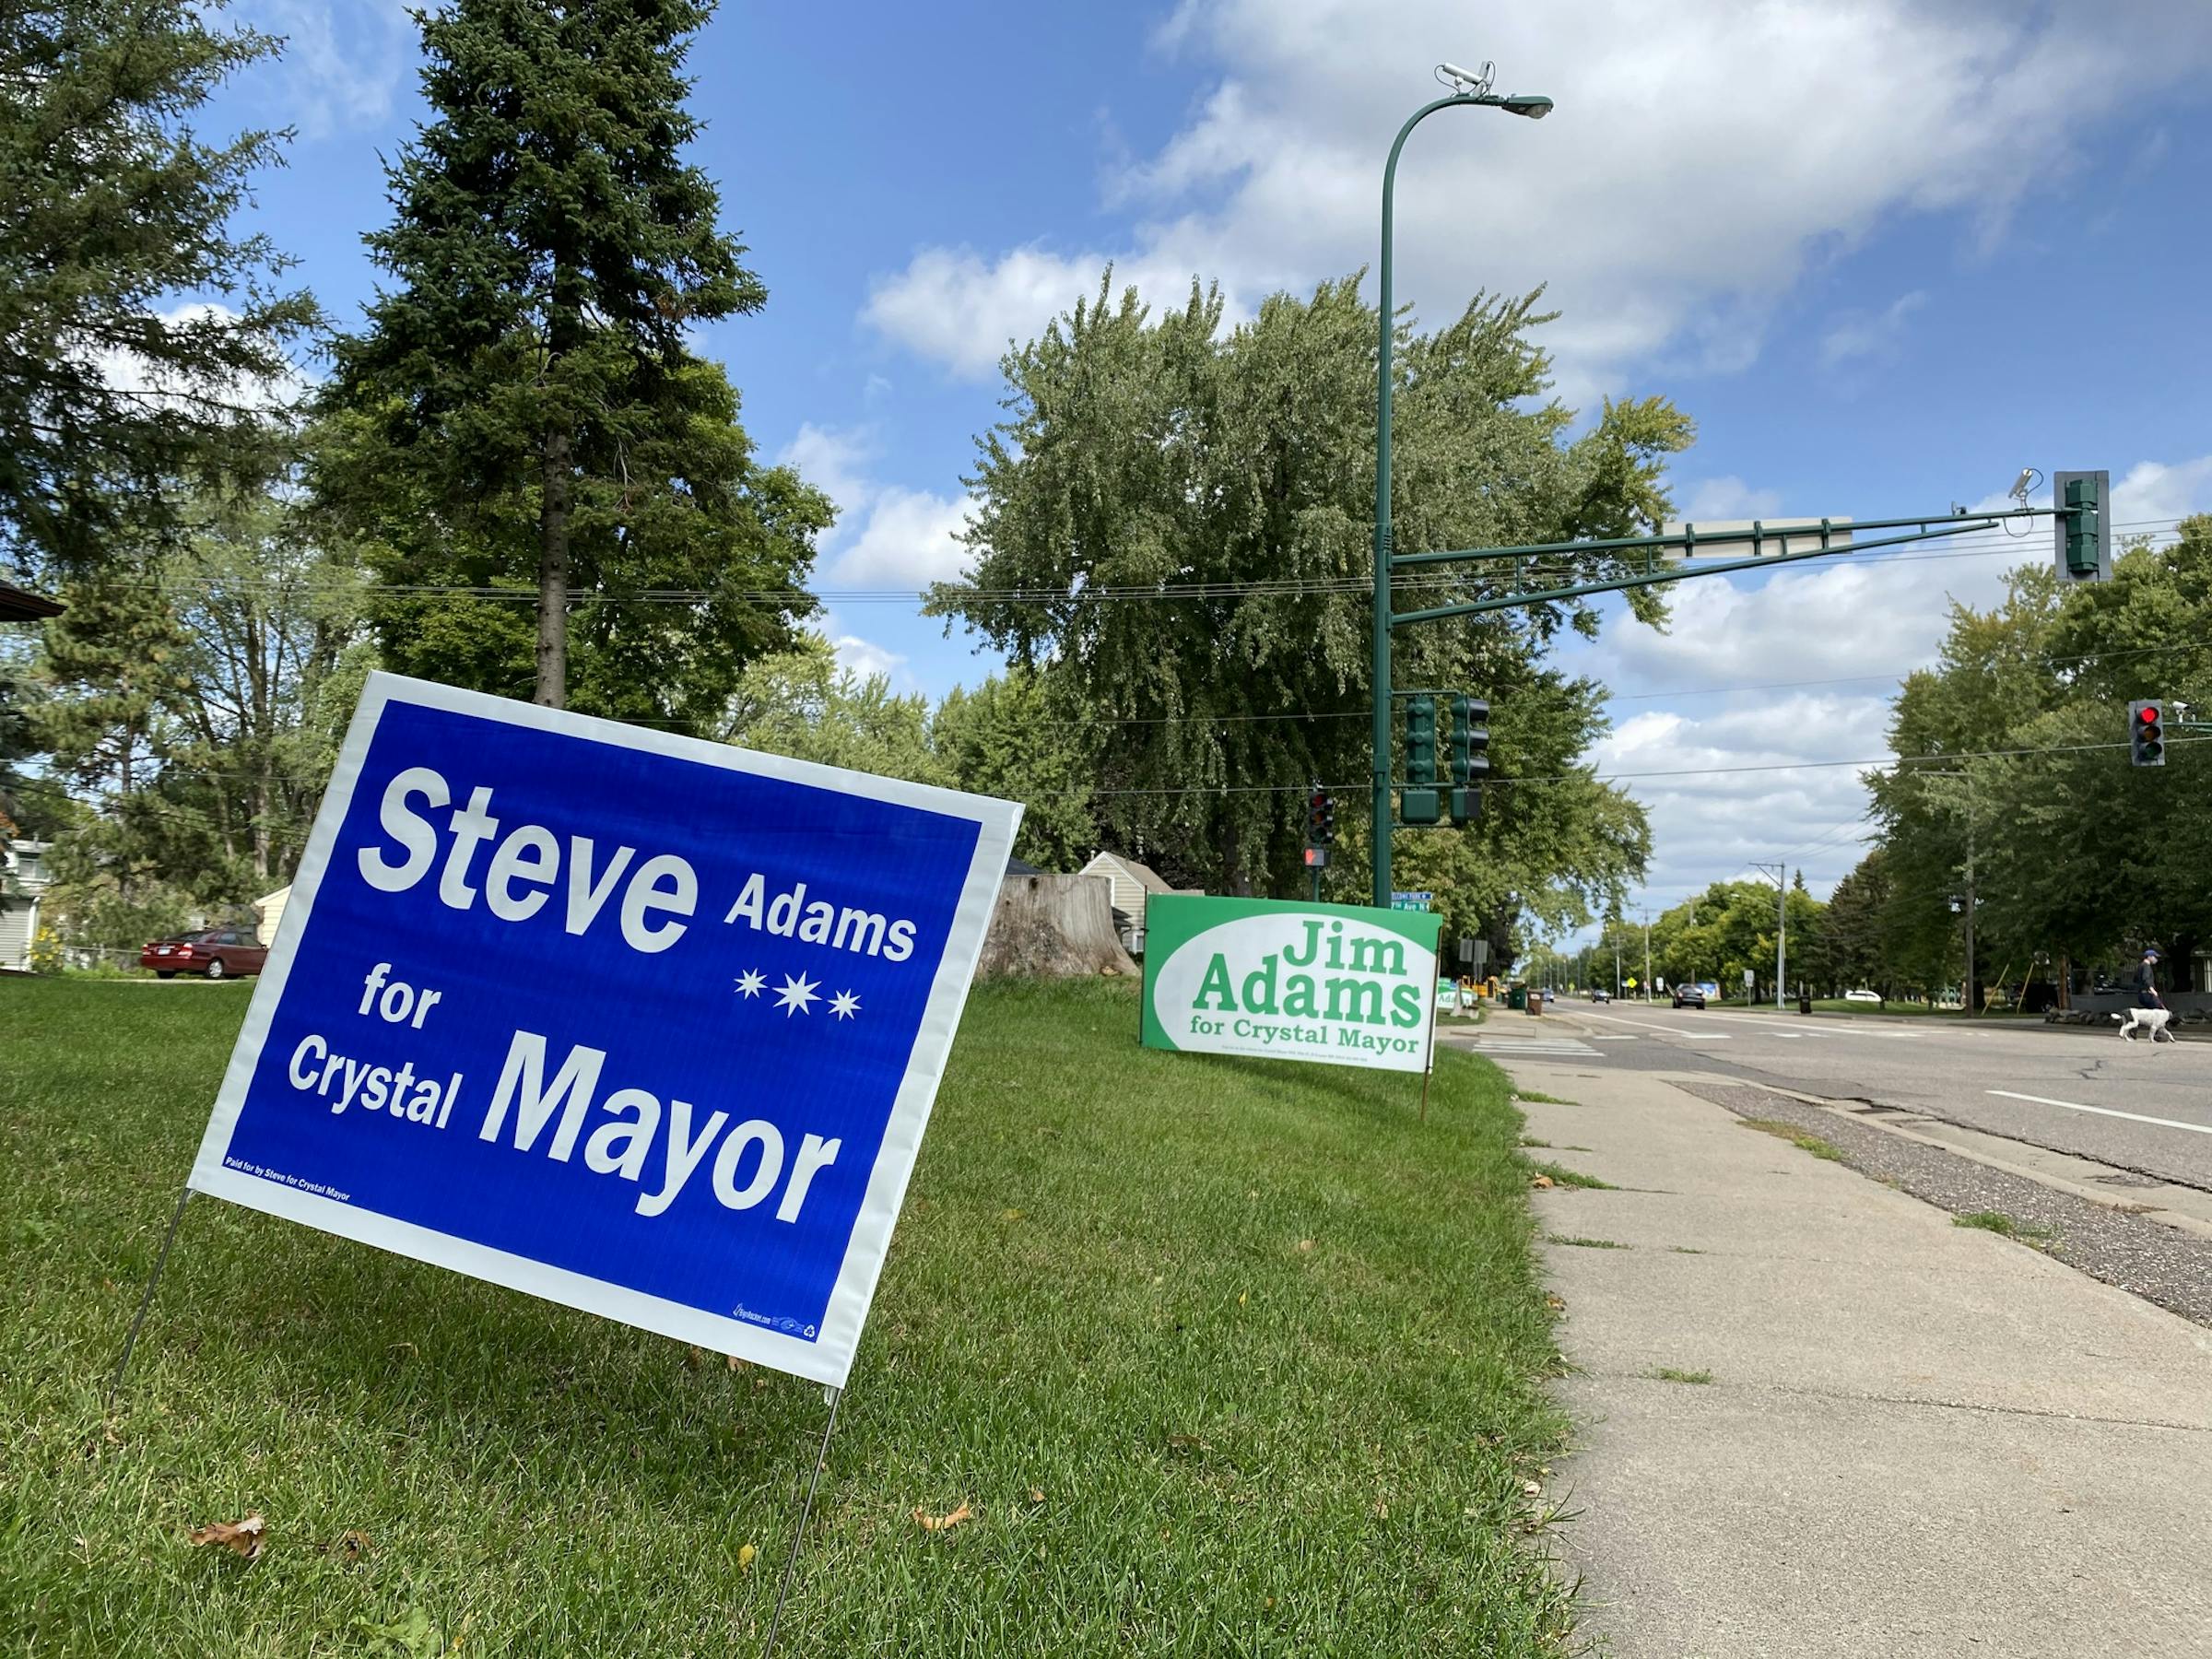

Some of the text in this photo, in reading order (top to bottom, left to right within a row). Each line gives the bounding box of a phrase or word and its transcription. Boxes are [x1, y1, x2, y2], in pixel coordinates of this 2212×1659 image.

[359, 768, 917, 962] Steve Adams
[1282, 920, 1407, 976] Jim
[358, 962, 442, 1030] for
[1192, 952, 1421, 1029] Adams
[1190, 1015, 1225, 1035] for
[1233, 1018, 1328, 1044] Crystal
[1338, 1028, 1419, 1055] Mayor
[288, 1030, 842, 1224] Crystal Mayor
[225, 1156, 350, 1200] Paid for by Steve for Crystal Mayor
